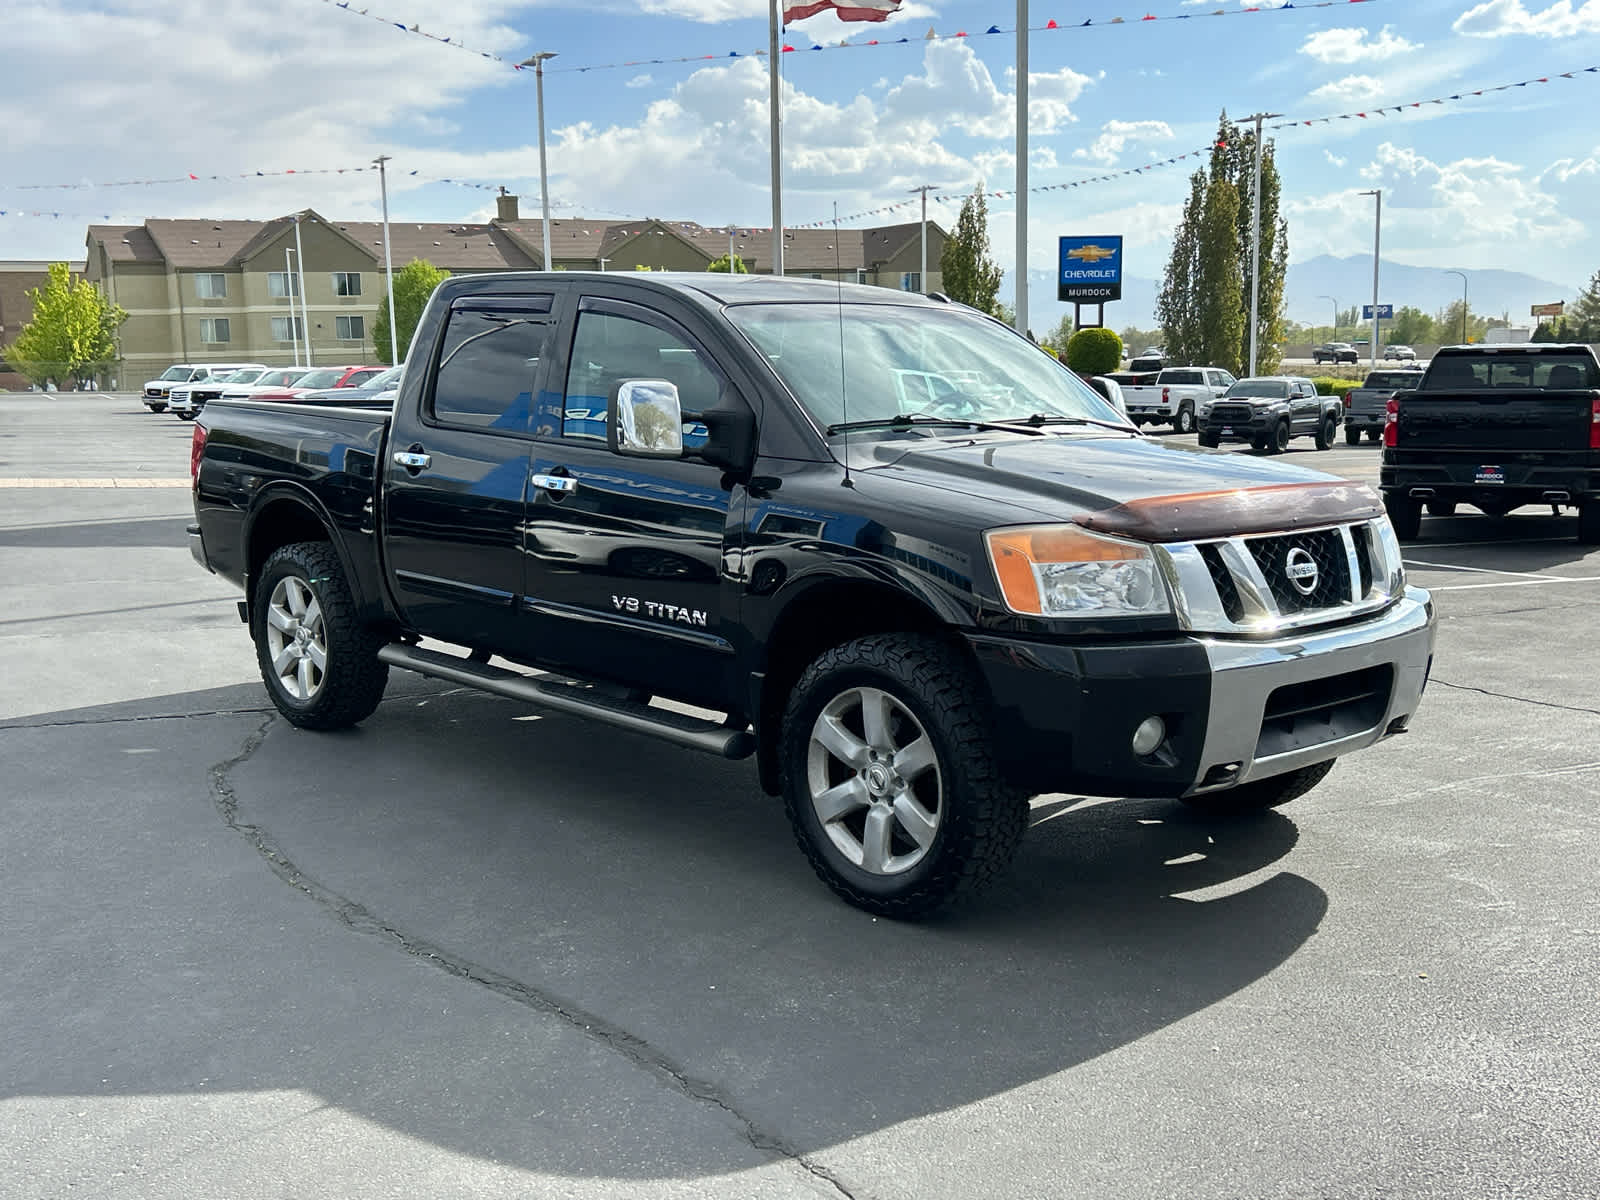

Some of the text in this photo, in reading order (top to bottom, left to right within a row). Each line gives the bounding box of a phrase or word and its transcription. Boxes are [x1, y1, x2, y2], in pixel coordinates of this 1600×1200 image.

[1064, 269, 1116, 278] CHEVROLET
[1068, 288, 1111, 296] MURDOCK
[611, 594, 707, 627] V8 TITAN
